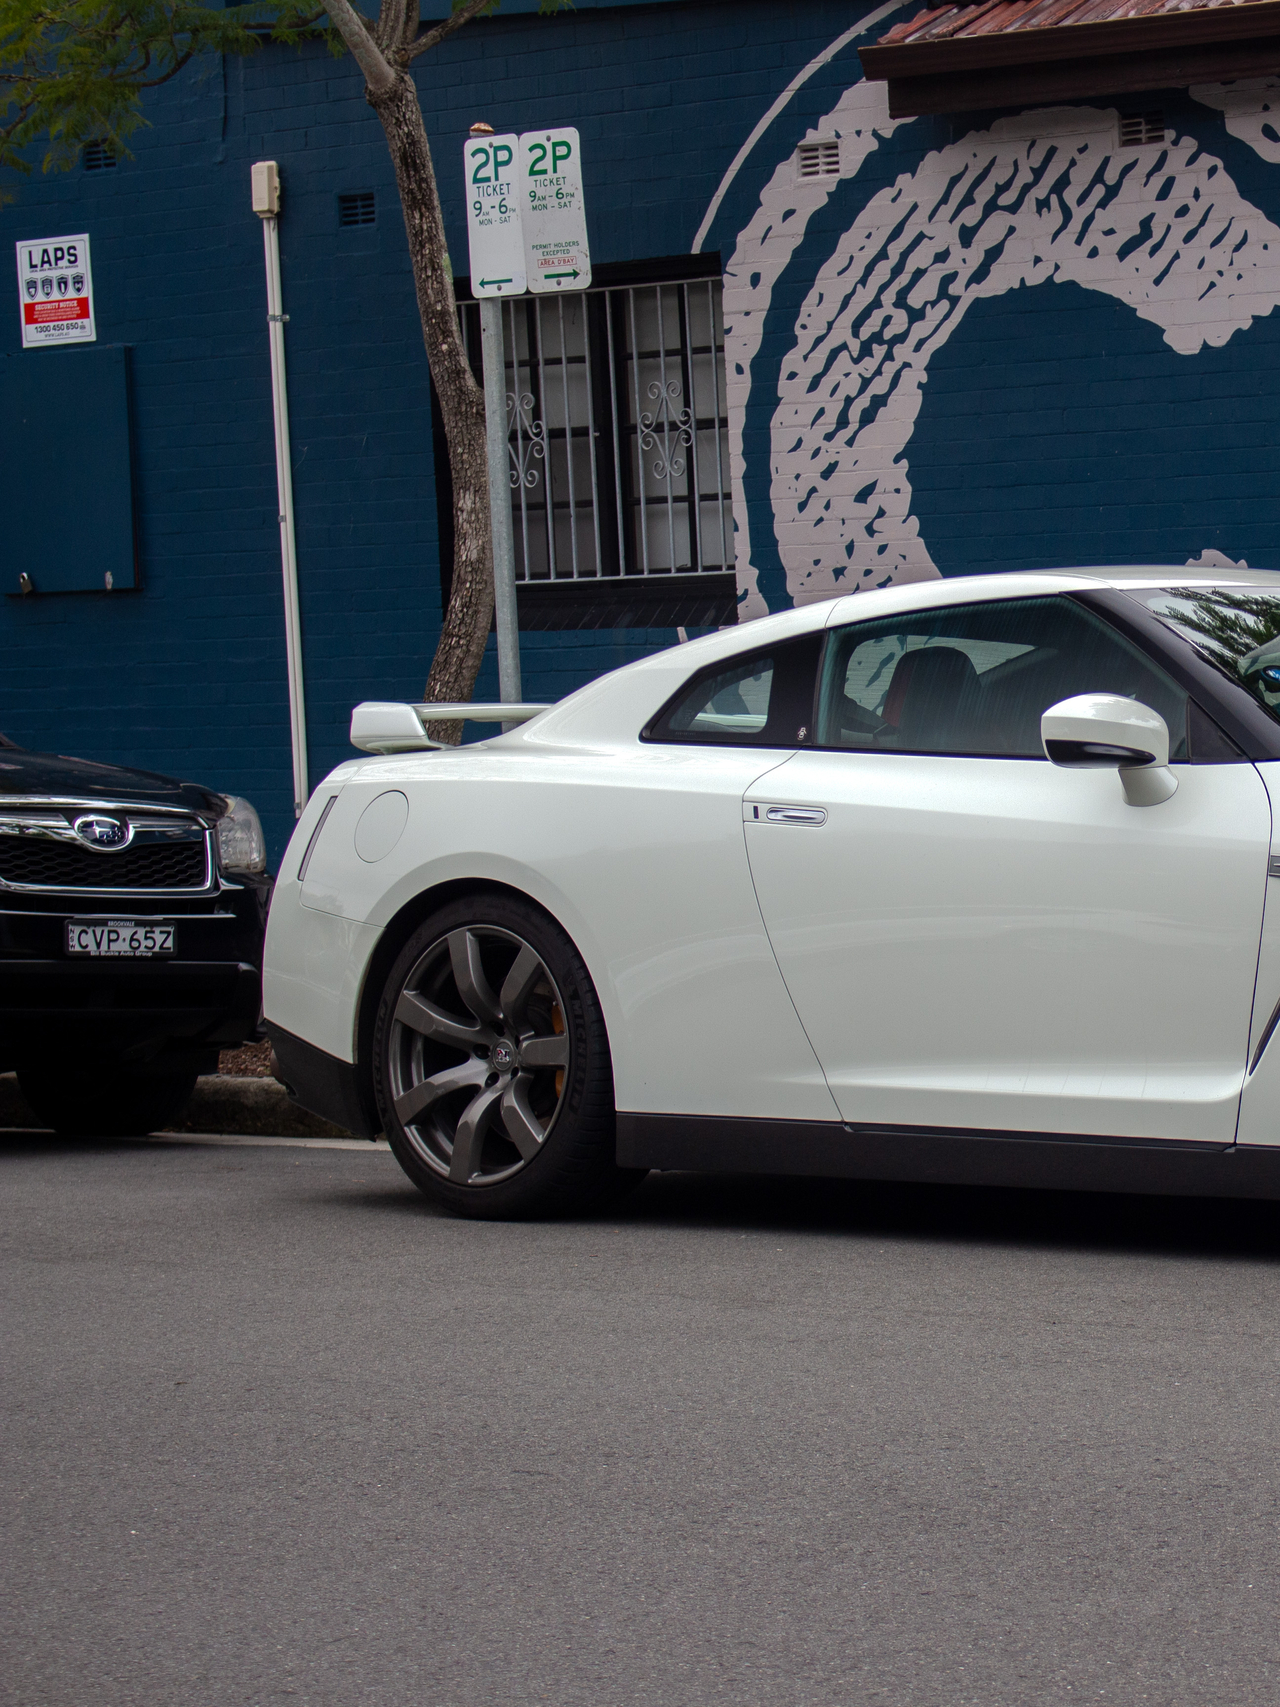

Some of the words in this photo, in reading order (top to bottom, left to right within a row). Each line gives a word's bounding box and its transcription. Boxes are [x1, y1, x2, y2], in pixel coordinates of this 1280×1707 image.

[471, 144, 513, 184] 2P
[528, 140, 572, 177] 2P
[534, 177, 566, 188] TICKET
[476, 183, 511, 198] TICKET
[499, 216, 511, 224] SAT
[28, 245, 78, 269] LAPS
[35, 302, 58, 311] SECURITY
[35, 325, 51, 333] 1300
[52, 324, 64, 332] 450
[66, 322, 78, 330] 650
